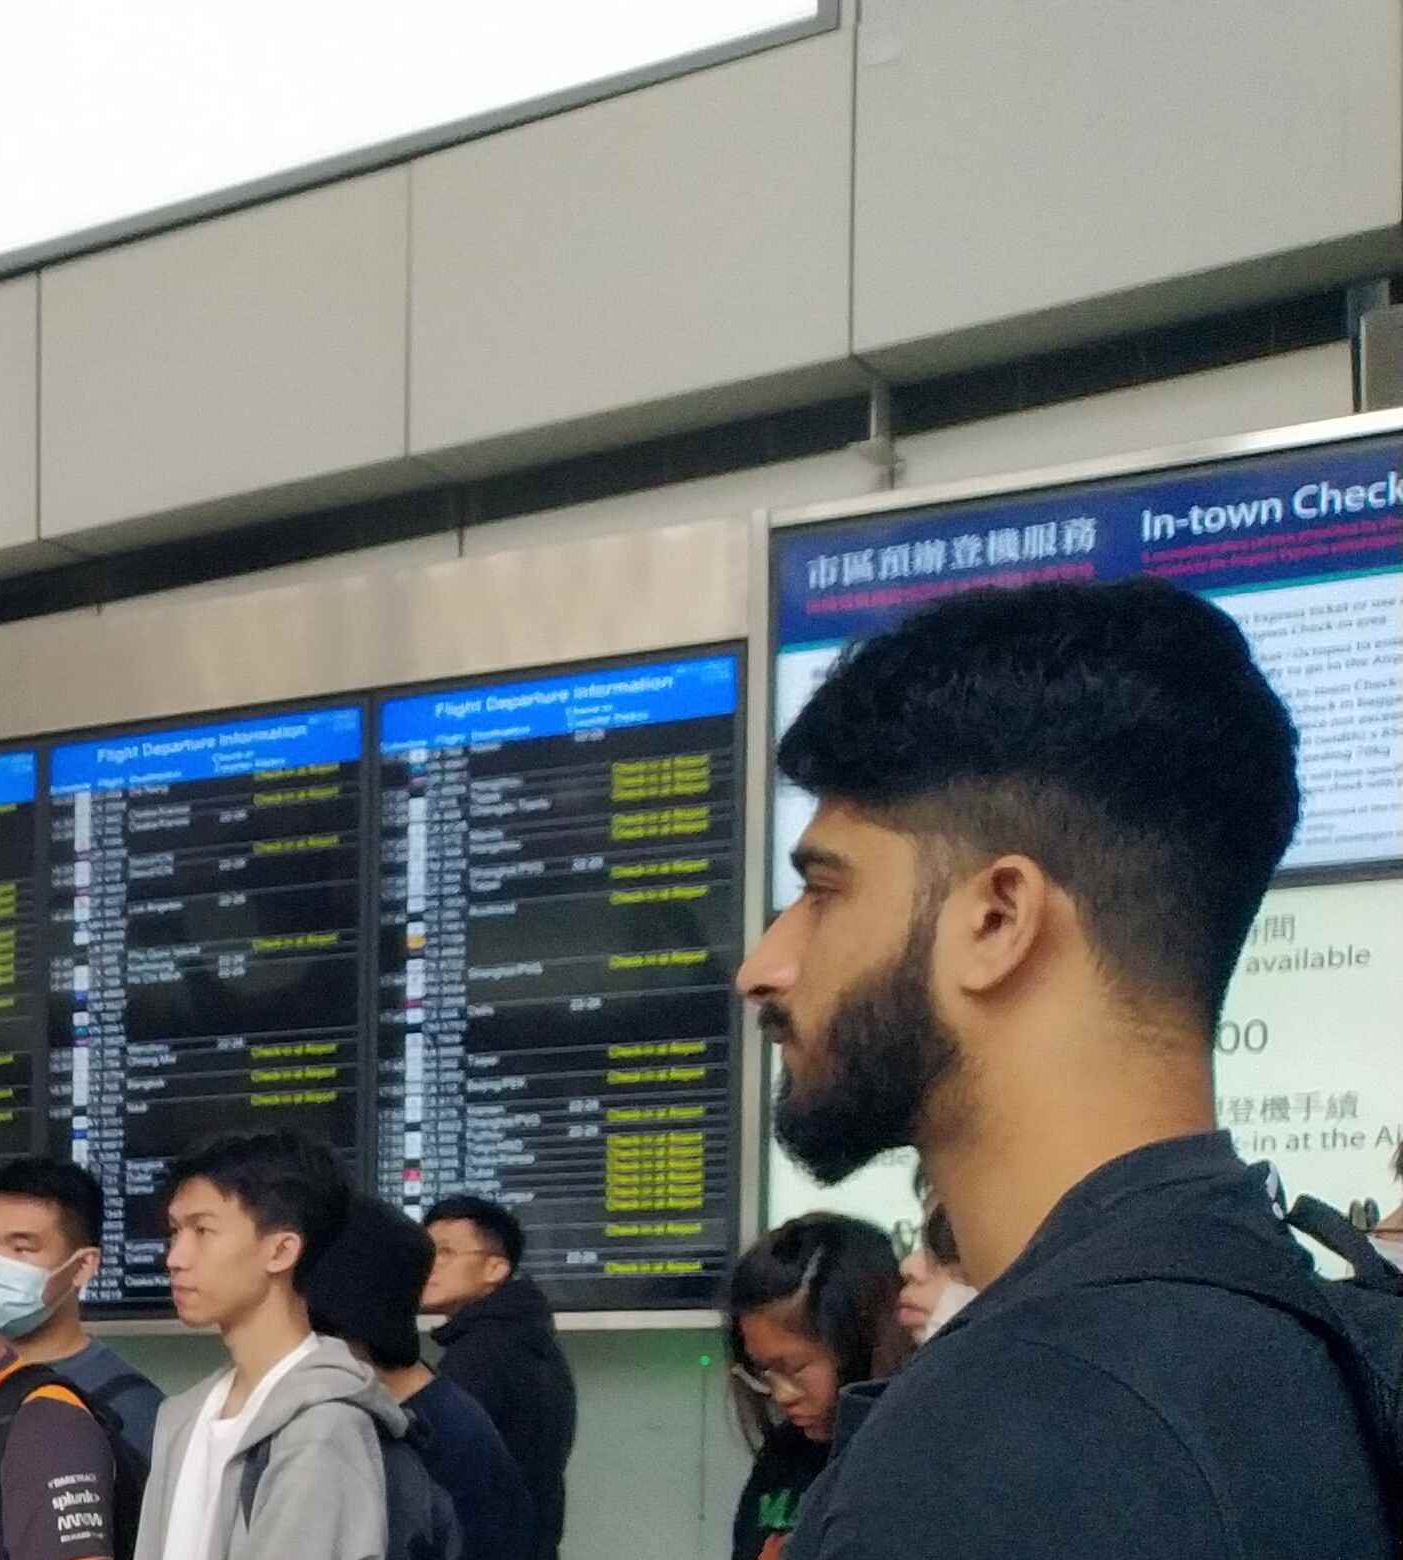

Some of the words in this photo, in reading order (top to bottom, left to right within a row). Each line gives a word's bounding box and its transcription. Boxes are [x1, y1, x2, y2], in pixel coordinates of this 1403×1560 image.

[1141, 497, 1284, 542] In-town
[1250, 914, 1296, 946] 間
[1245, 944, 1372, 975] available
[1218, 1090, 1359, 1124] 登機手續
[1285, 1132, 1312, 1152] at
[1321, 1128, 1366, 1150] the
